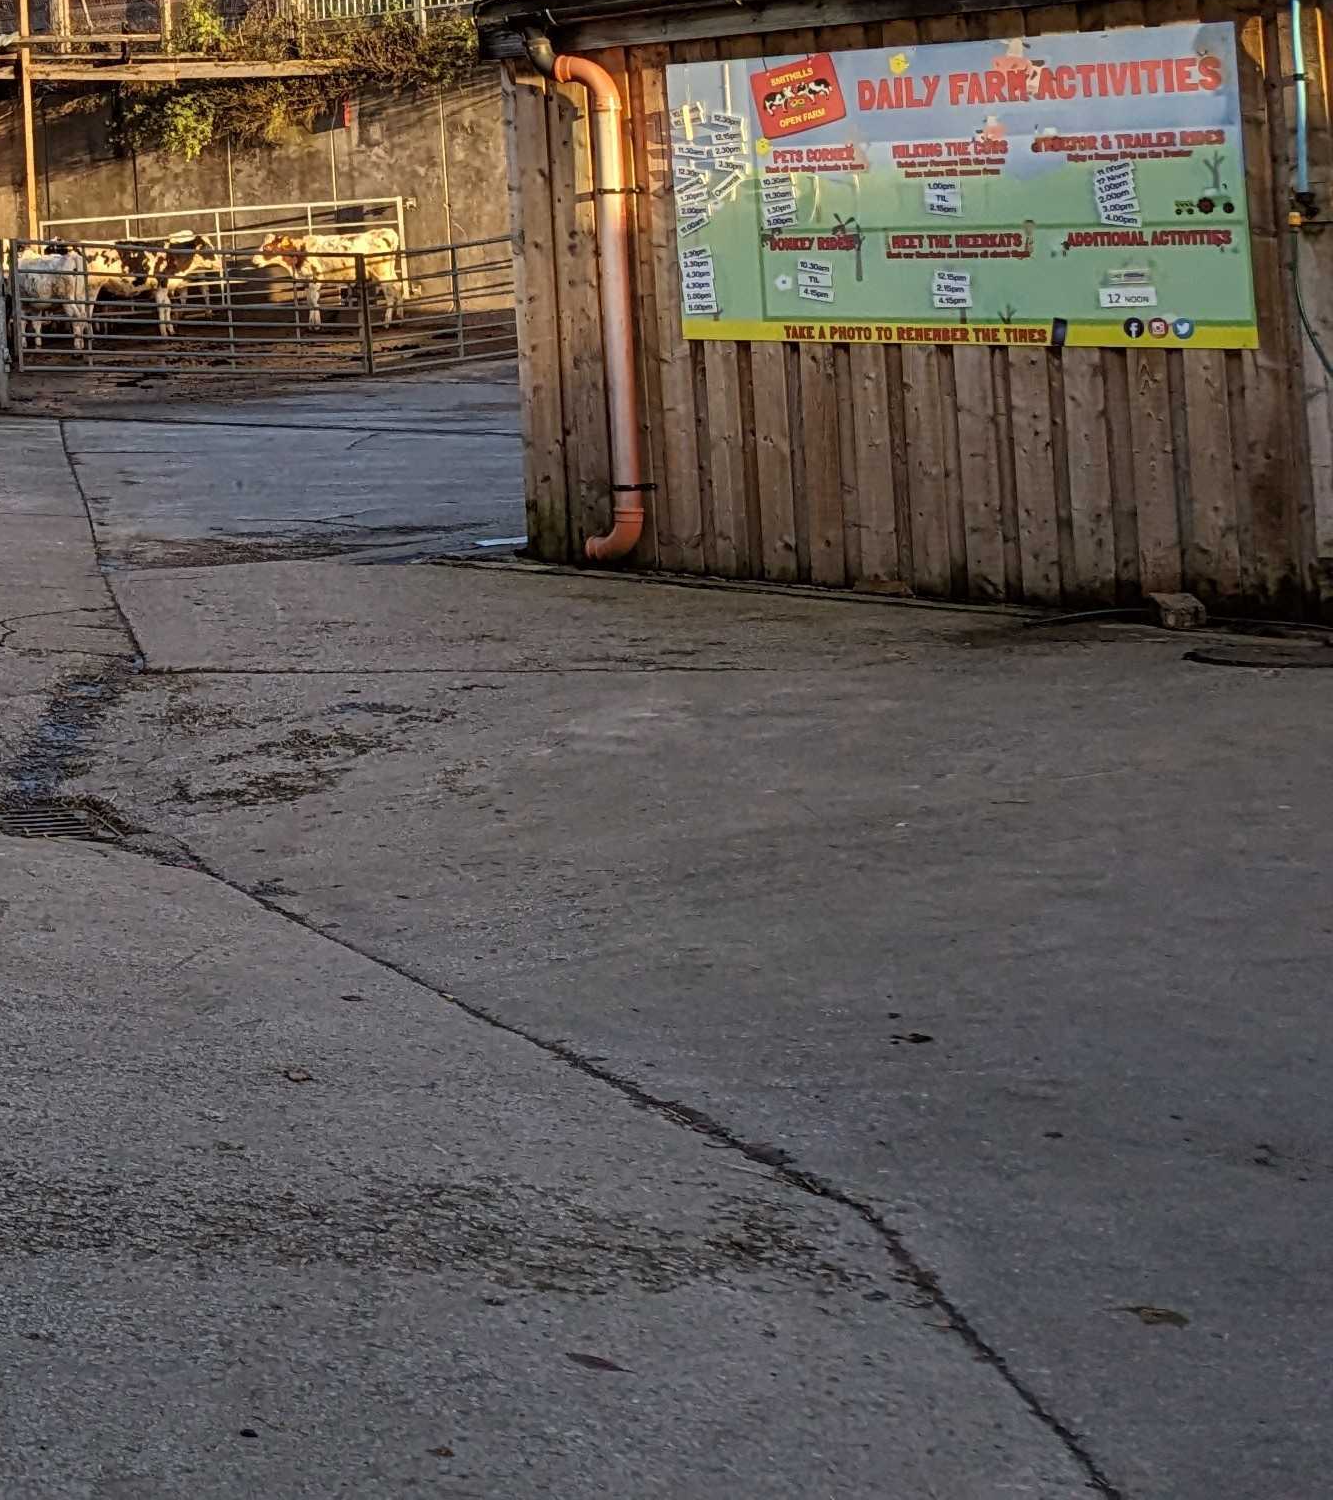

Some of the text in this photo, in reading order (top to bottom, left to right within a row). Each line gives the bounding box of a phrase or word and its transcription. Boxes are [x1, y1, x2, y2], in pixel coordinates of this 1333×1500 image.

[857, 55, 1223, 111] DAILY FARM ACTIVITIES
[779, 108, 826, 128] OPEN FARM
[1100, 134, 1112, 149] &
[1115, 131, 1176, 149] TRAILER
[715, 146, 741, 155] 2.30pm
[945, 141, 971, 156] THE
[772, 146, 855, 164] PETS CORNER
[928, 182, 955, 190] 1.00pm
[1098, 180, 1128, 193] 1.00pm
[936, 194, 949, 202] TIL
[1098, 189, 1129, 203] 2.00pm
[1105, 215, 1138, 225] 4.00pm
[892, 233, 1023, 249] MEET THE MEERKATS
[1067, 229, 1233, 247] ADDITIONAL ACTIVITIES
[799, 261, 830, 272] 10.30am
[808, 276, 820, 284] TIL
[937, 272, 967, 281] 12.15pm
[803, 288, 829, 299] 4.15pm
[936, 284, 965, 293] 2.15pm
[938, 297, 967, 305] 4.15pm
[1107, 293, 1121, 304] 12
[783, 325, 1048, 343] TAKE A PHOTO TO REMEMBER THE TIMES
